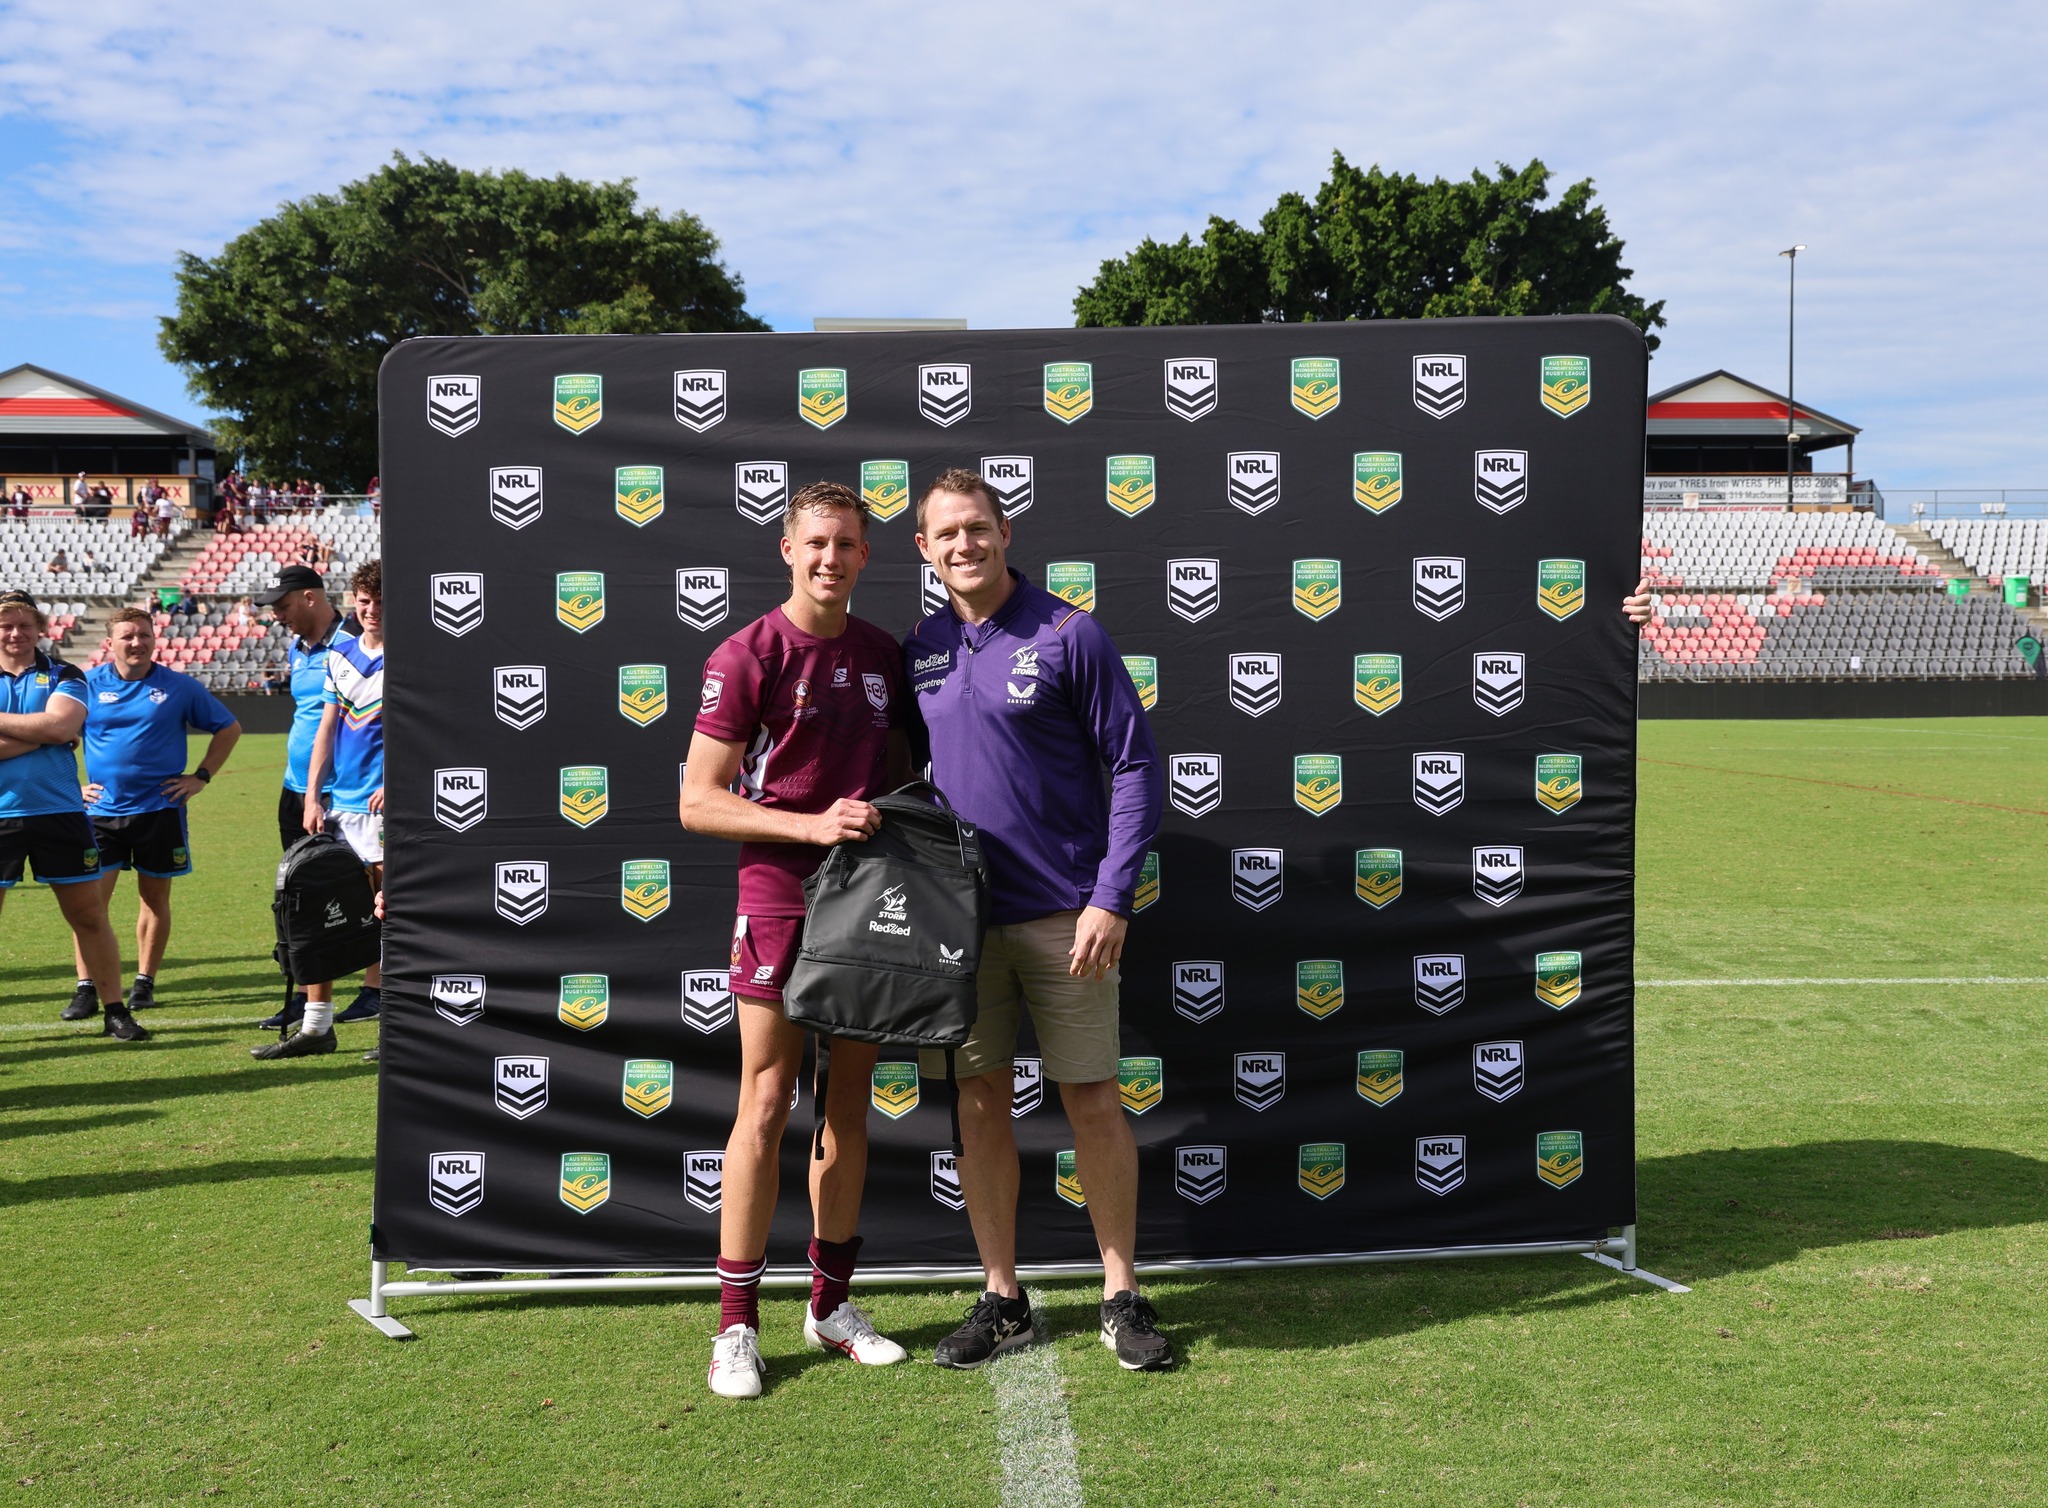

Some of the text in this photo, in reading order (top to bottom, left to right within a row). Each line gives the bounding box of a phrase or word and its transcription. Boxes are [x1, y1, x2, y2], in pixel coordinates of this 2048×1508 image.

[1172, 365, 1211, 380] NRL
[1421, 362, 1460, 376] NRL
[682, 377, 720, 391] NRL
[926, 371, 964, 385] NRL
[435, 382, 473, 396] NRL
[989, 463, 1027, 478] NRL
[1235, 459, 1273, 473] NRL
[1483, 457, 1521, 472] NRL
[498, 474, 536, 488] NRL
[743, 469, 781, 483] NRL
[1659, 481, 1677, 491] your
[1680, 479, 1707, 488] TYRES
[1709, 478, 1729, 488] from
[1731, 479, 1763, 488] WYERS
[1793, 478, 1812, 488] 833
[1814, 478, 1839, 488] 2006
[1175, 566, 1213, 580] NRL
[1421, 564, 1459, 578] NRL
[439, 580, 477, 595] NRL
[684, 575, 722, 589] NRL
[914, 650, 950, 672] RedZed
[1237, 660, 1275, 675] NRL
[1481, 660, 1518, 674] NRL
[1011, 667, 1039, 676] STORM
[502, 673, 540, 688] NRL
[918, 678, 946, 691] cointree
[1177, 761, 1215, 775] NRL
[1421, 760, 1458, 774] NRL
[442, 775, 480, 790] NRL
[1239, 856, 1277, 870] NRL
[1480, 853, 1517, 867] NRL
[503, 869, 542, 883] NRL
[878, 911, 907, 921] STORM
[869, 920, 911, 936] RedZed
[1180, 968, 1218, 982] NRL
[1422, 963, 1458, 976] NRL
[441, 979, 477, 994] NRL
[690, 978, 726, 991] NRL
[1480, 1048, 1516, 1061] NRL
[503, 1064, 541, 1078] NRL
[1241, 1059, 1279, 1073] NRL
[1423, 1142, 1460, 1156] NRL
[1183, 1152, 1220, 1166] NRL
[437, 1159, 477, 1174] NRL
